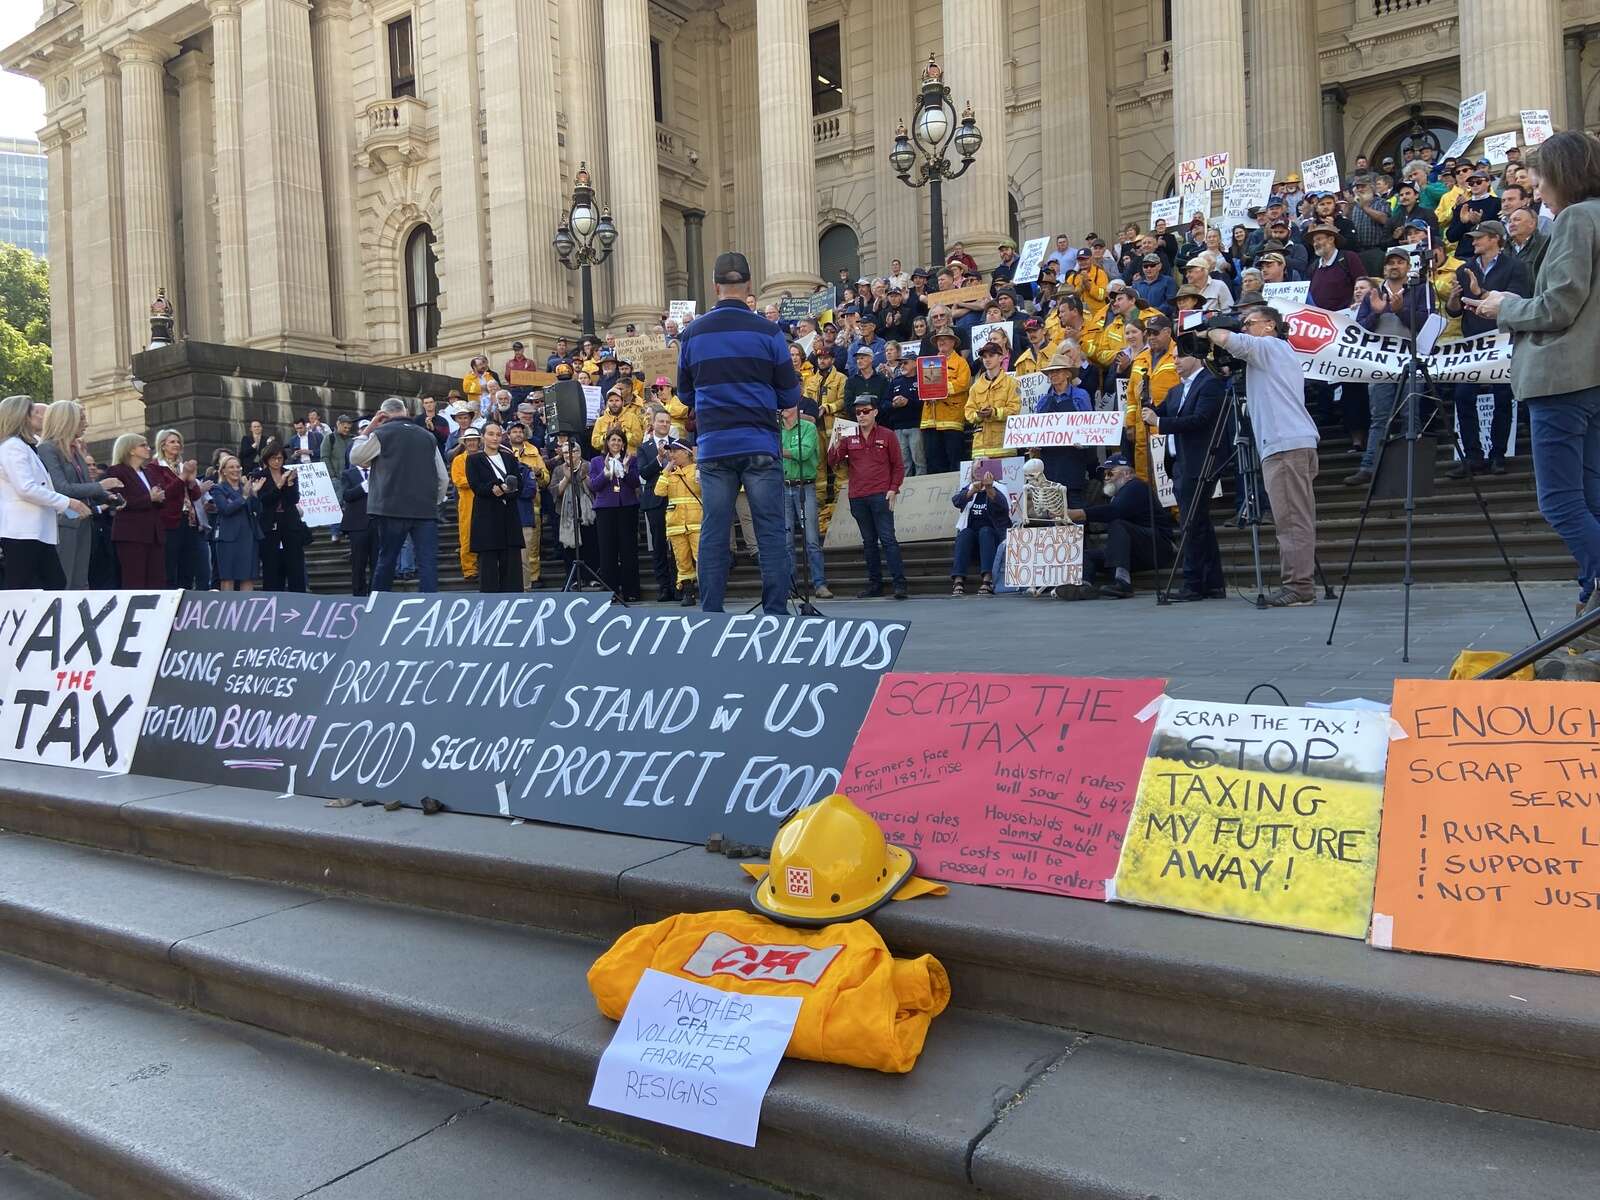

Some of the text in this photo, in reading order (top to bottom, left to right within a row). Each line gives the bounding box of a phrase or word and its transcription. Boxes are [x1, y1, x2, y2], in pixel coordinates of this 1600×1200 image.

[1180, 166, 1225, 183] TAX ON
[1182, 153, 1228, 172] NO NEW
[1184, 182, 1196, 193] MY
[1204, 176, 1227, 191] LAND
[1278, 286, 1291, 295] ARE
[1294, 285, 1308, 294] NOT
[1288, 317, 1333, 339] STOP
[1337, 343, 1499, 368] THAN YU HAVE
[1021, 374, 1044, 388] BBED
[1320, 360, 1362, 379] then
[1007, 412, 1120, 430] COUNTRY WOMENS
[1005, 430, 1074, 445] ASSOCIATION
[1085, 434, 1106, 443] TAX
[1008, 525, 1083, 545] NO FARMS
[1007, 543, 1080, 564] NO FOOD
[1006, 564, 1083, 585] NO FUTURE
[173, 596, 365, 640] JACINTA LIES
[16, 595, 161, 671] AXE
[599, 613, 905, 670] CITY FRIENDS
[160, 646, 336, 686] USING EMERGENCY
[56, 670, 96, 691] THE
[224, 673, 297, 698] SERVICES
[326, 659, 553, 708] PROTECTING
[550, 684, 700, 734] STAND
[764, 682, 838, 738] US
[886, 680, 1123, 722] SCRAP THE
[14, 689, 134, 767] TAX
[214, 704, 317, 750] BLOWOUT
[1173, 711, 1239, 727] SCRAP
[1250, 714, 1288, 731] THE
[307, 719, 536, 789] FOOD SECURIT
[854, 749, 949, 779] Farmers face
[1184, 735, 1339, 775] STOP
[521, 745, 726, 807] PROTECT
[844, 778, 882, 796] painful
[938, 761, 962, 775] rise
[994, 761, 1126, 792] Industrial rates
[1409, 758, 1598, 784] SCRAP TH
[996, 781, 1021, 794] will
[1029, 786, 1064, 800] soar
[1076, 791, 1091, 809] by
[1157, 773, 1327, 816] TAXING
[1509, 790, 1600, 808] SERV
[869, 811, 960, 827] mercial rates
[985, 804, 1064, 832] Households
[1073, 822, 1103, 837] will
[1052, 833, 1097, 857] double
[1145, 812, 1366, 863] MY FUTURE
[1443, 821, 1555, 844] RURAL
[1012, 850, 1037, 863] will
[1045, 854, 1063, 868] be
[1160, 849, 1294, 891] AWAY!
[1444, 854, 1583, 875] SUPPORT
[939, 859, 1106, 892] passed on to renters
[790, 884, 809, 894] CFA
[1437, 881, 1511, 901] NOT
[711, 945, 812, 976] CFA
[663, 989, 753, 1021] ANOTHER
[636, 1016, 752, 1056] VOLUNTEER
[677, 1015, 708, 1031] CFA
[640, 1047, 717, 1075] FARMER
[625, 1070, 718, 1106] RESIGNS
